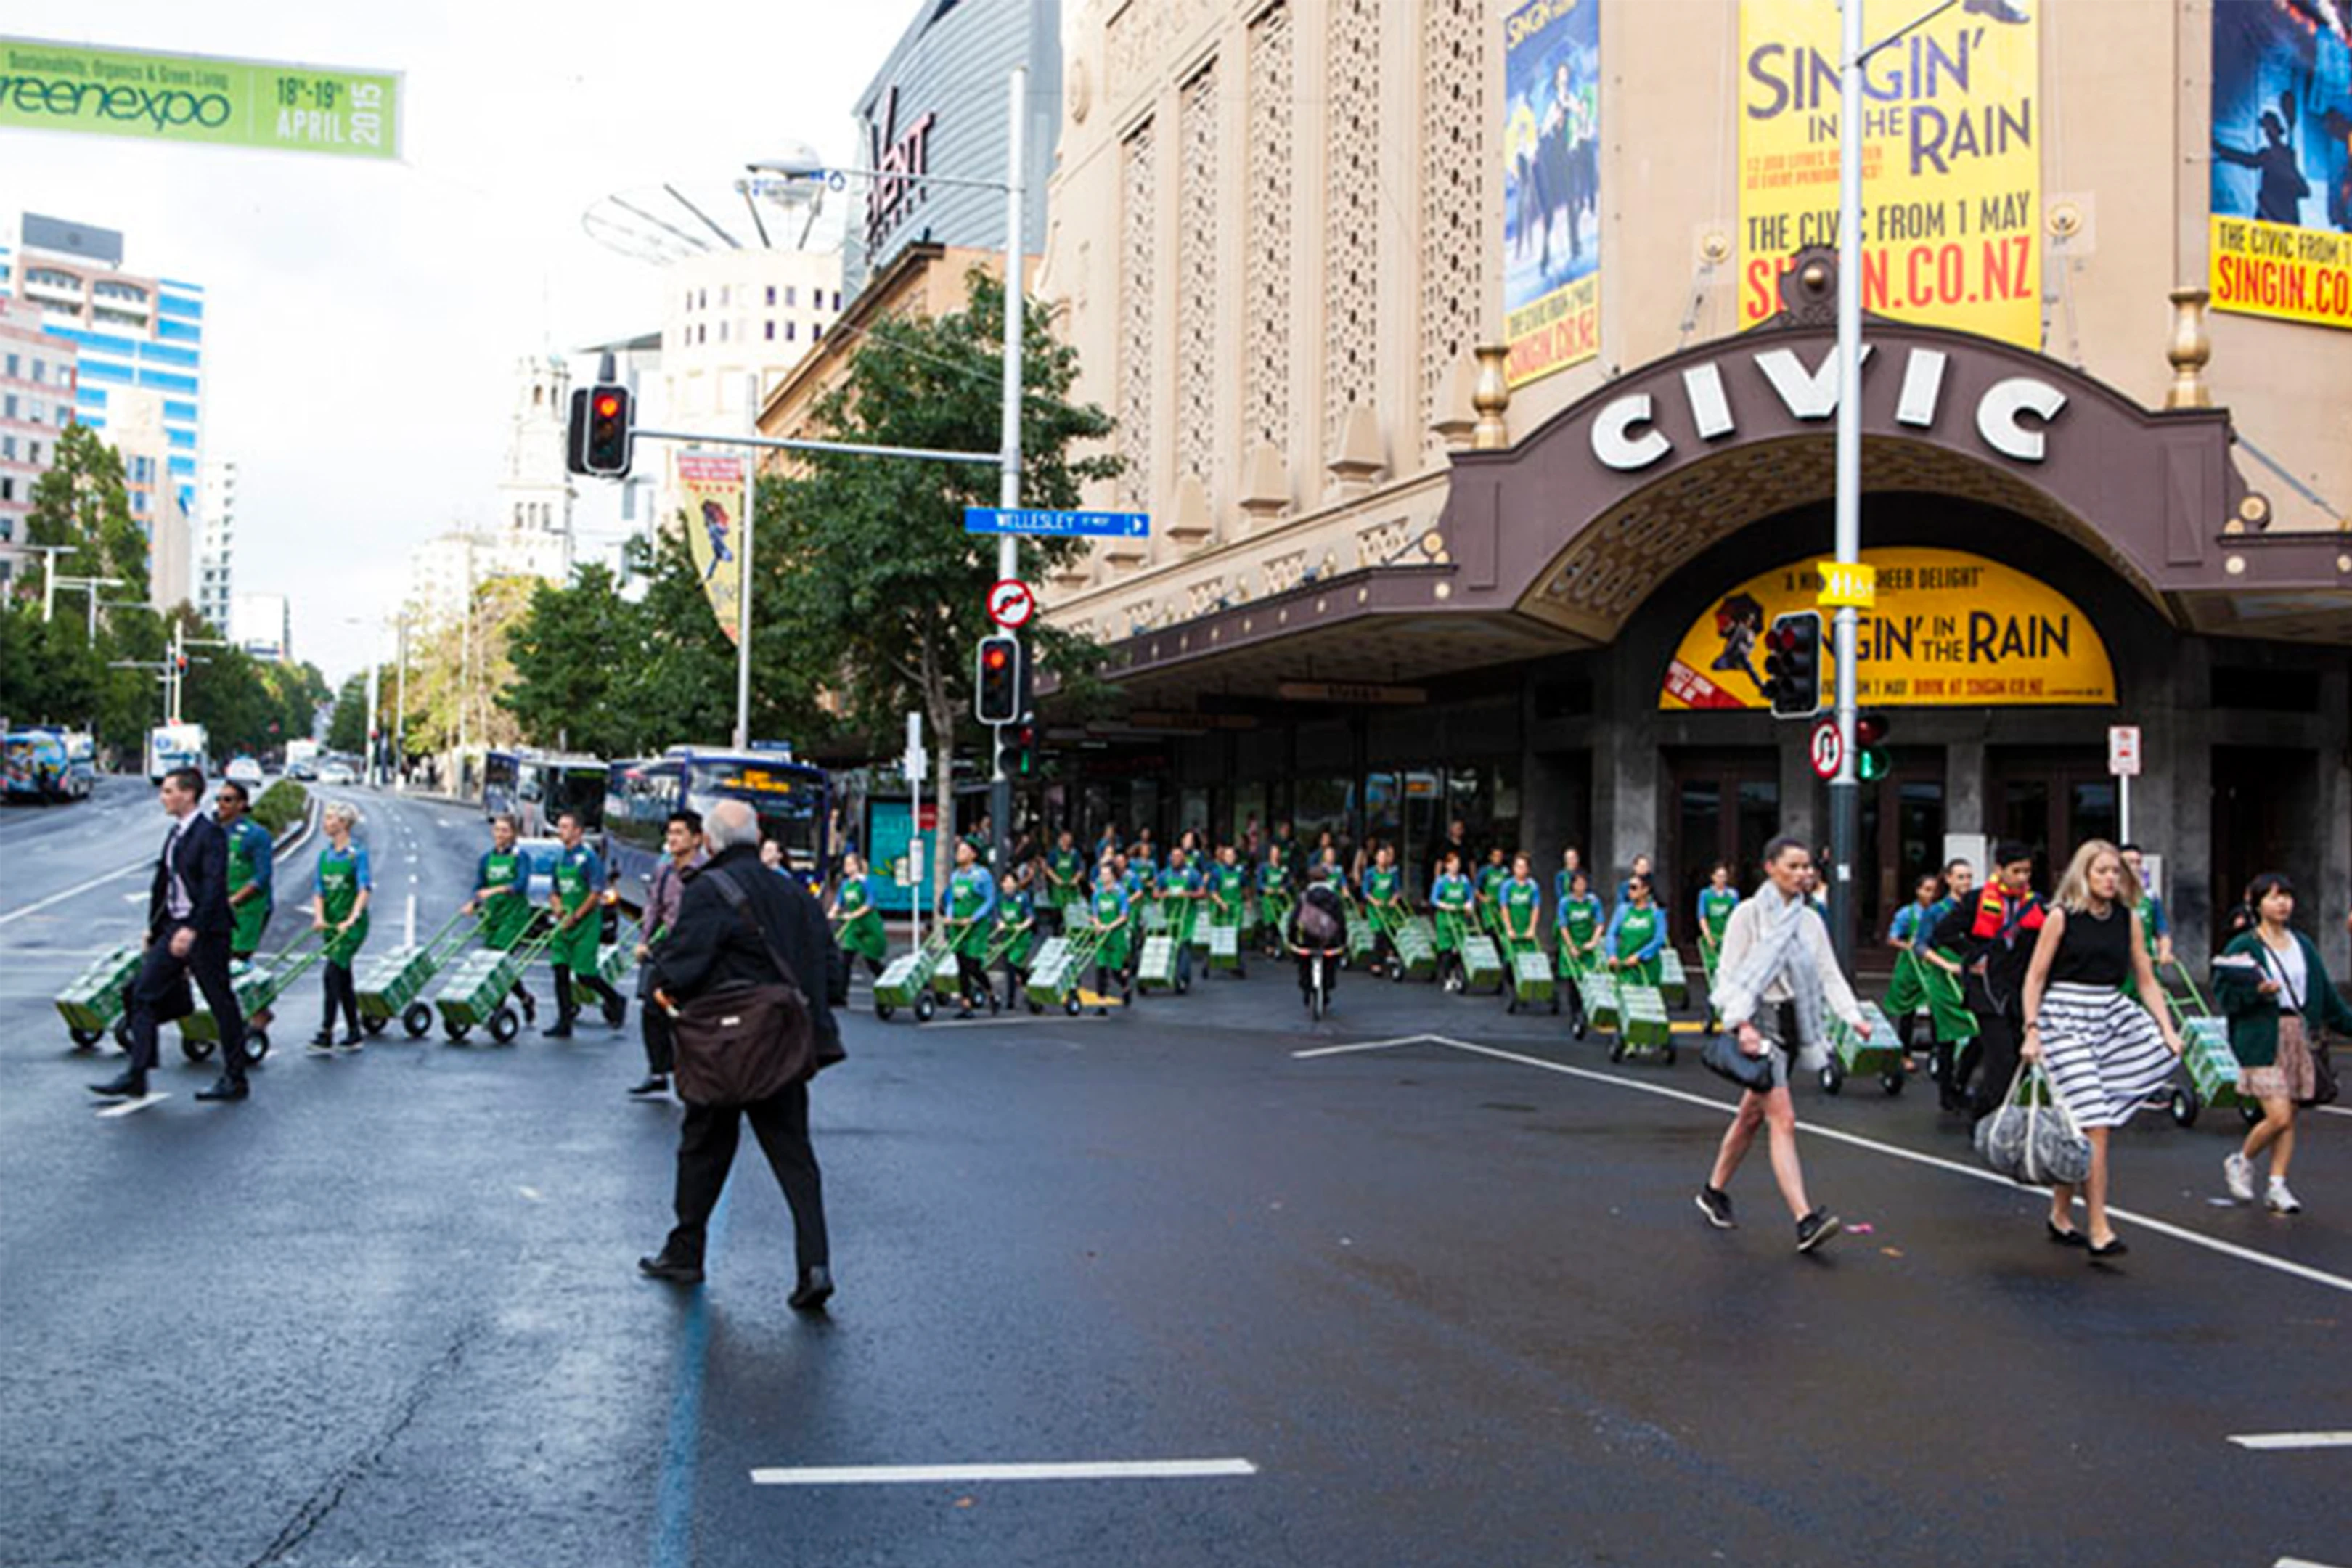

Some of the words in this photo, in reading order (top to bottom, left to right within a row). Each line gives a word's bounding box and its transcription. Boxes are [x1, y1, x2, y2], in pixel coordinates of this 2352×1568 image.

[276, 107, 346, 143] APRIL
[351, 83, 383, 147] 2015
[1809, 113, 1837, 143] IN
[1865, 107, 1903, 138] HE
[1911, 97, 2031, 176] RAIN
[1748, 214, 1789, 252] THE
[1799, 209, 1868, 248] CIV
[1877, 201, 1945, 242] FROM
[1957, 199, 1967, 234] 1
[1980, 190, 2031, 233] MAY
[2221, 221, 2245, 252] THE
[2252, 226, 2294, 259] CIVIC
[2298, 233, 2339, 265] FROM
[1591, 344, 2067, 470] CIVIC
[996, 513, 1075, 530] WELLESLEY
[1875, 568, 1914, 588] HEER
[1933, 616, 1956, 637] IN
[1969, 611, 2070, 663] RAIN
[1921, 639, 1964, 663] THE
